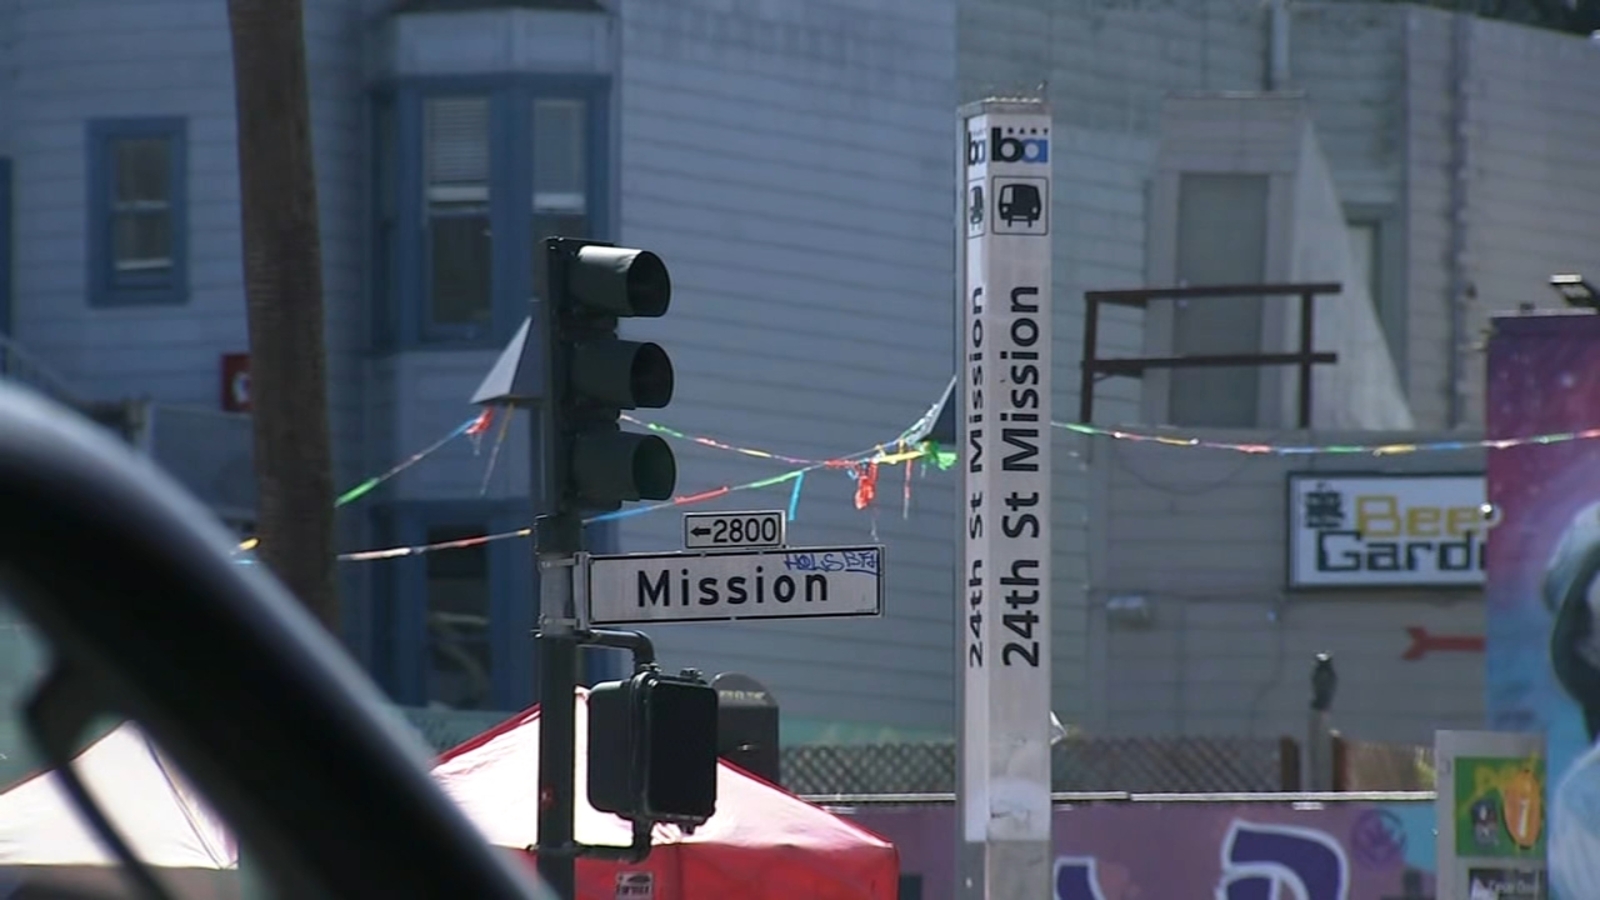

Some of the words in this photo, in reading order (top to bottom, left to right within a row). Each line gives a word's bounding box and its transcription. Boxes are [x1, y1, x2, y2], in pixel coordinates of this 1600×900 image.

[969, 287, 983, 473] Mission
[1000, 286, 1039, 472] Mission
[712, 517, 777, 543] 2800
[969, 491, 983, 539] St
[1002, 492, 1040, 538] St
[637, 565, 828, 607] Mission
[969, 559, 983, 668] 24th
[1000, 559, 1040, 667] 24th
